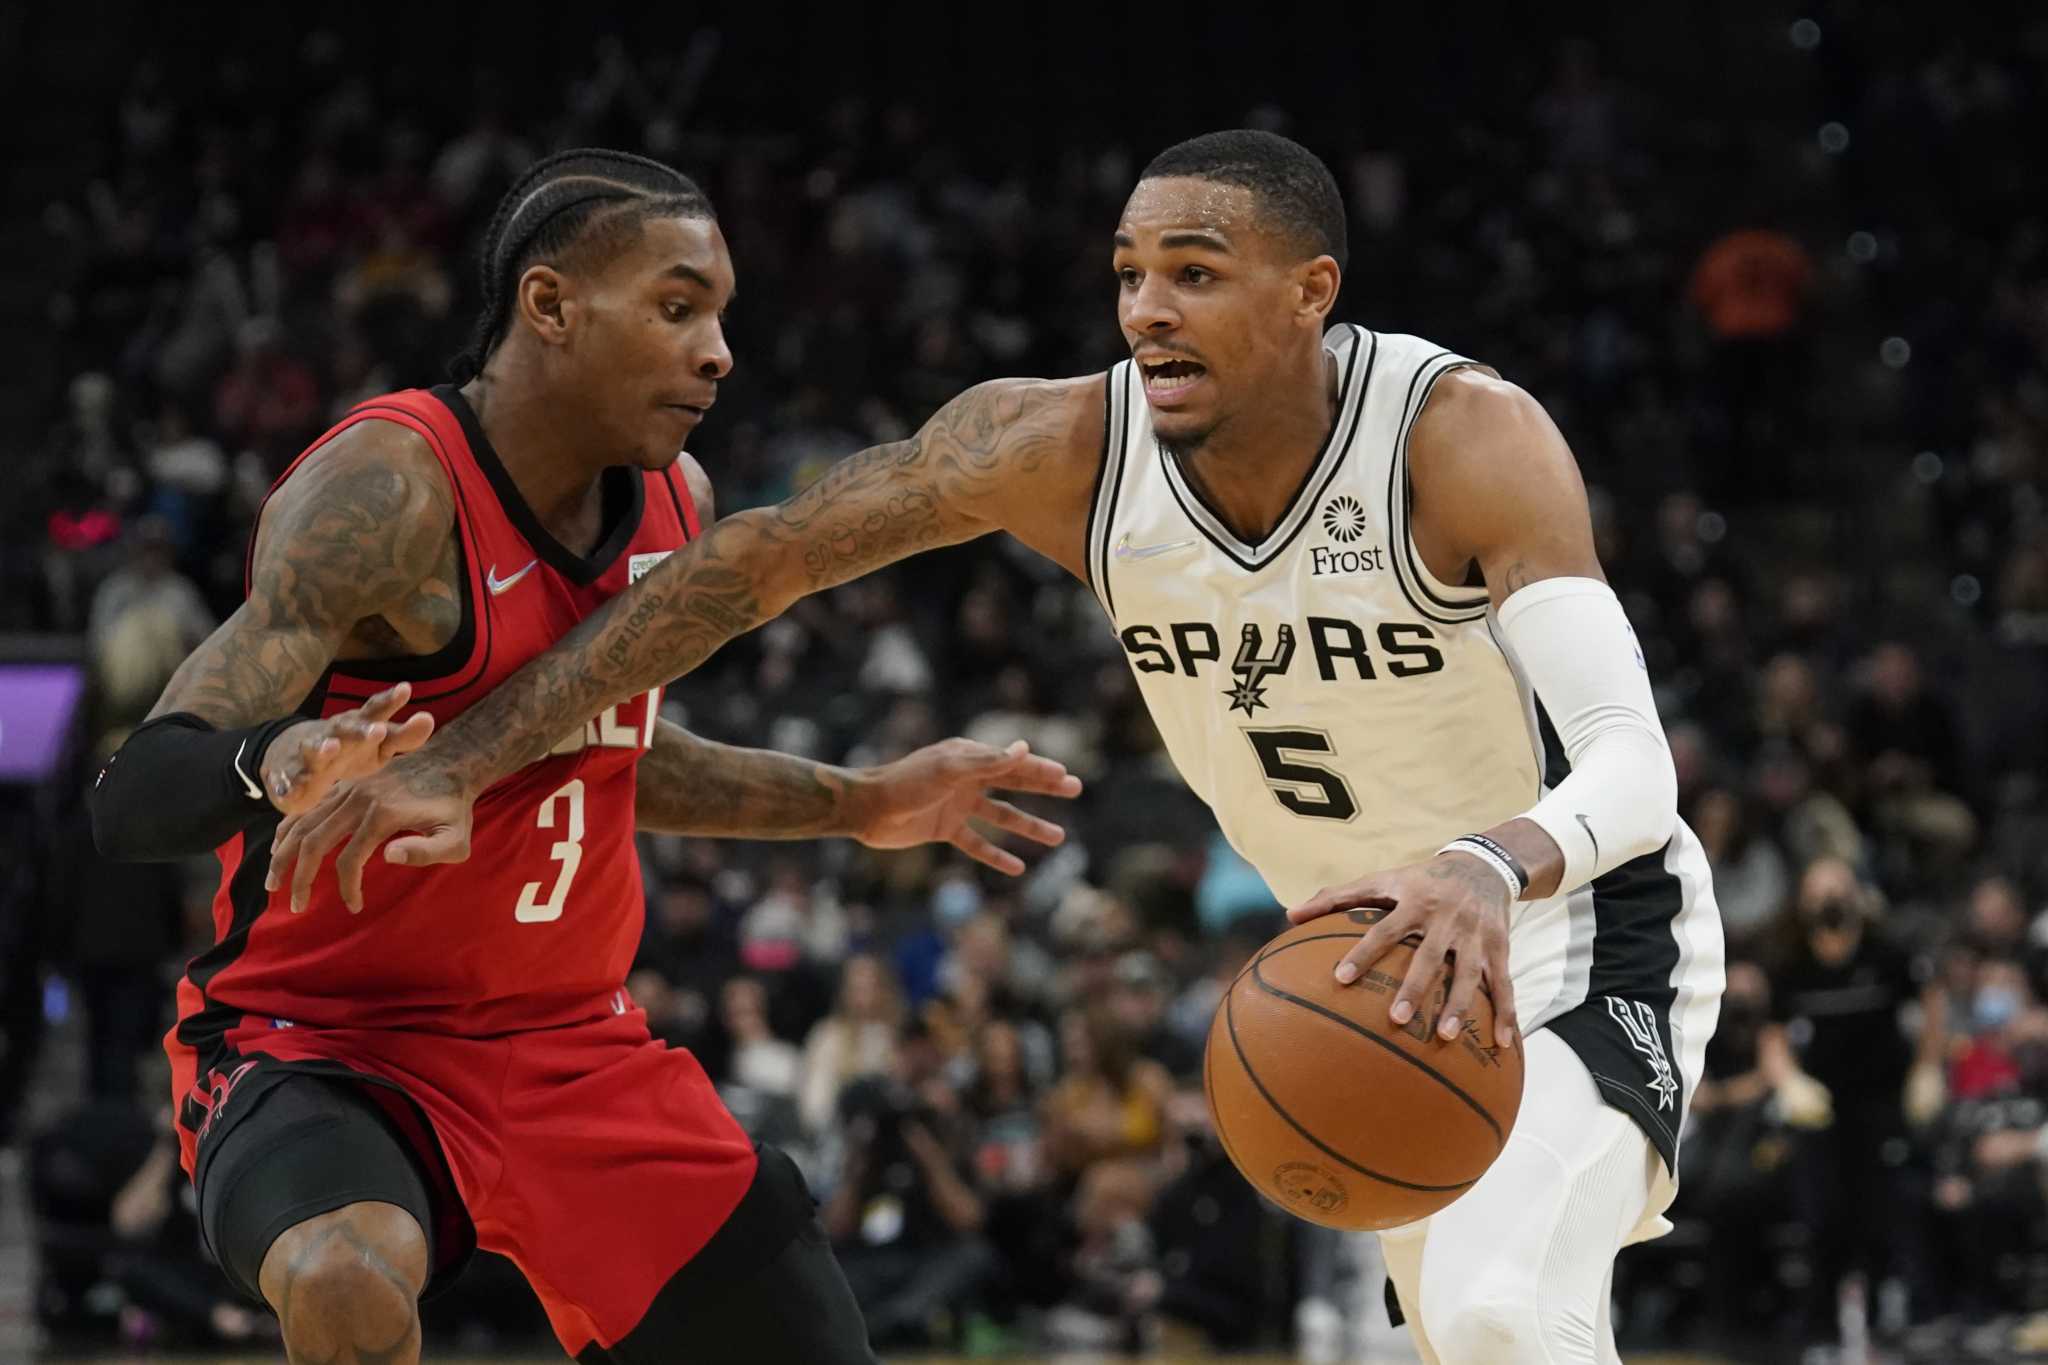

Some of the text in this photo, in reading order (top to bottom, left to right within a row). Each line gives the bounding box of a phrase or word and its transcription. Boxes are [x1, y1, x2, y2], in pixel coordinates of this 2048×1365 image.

[1310, 544, 1385, 576] Frost
[1121, 616, 1445, 719] SPURS
[1240, 725, 1362, 823] 5
[515, 778, 585, 923] 3
